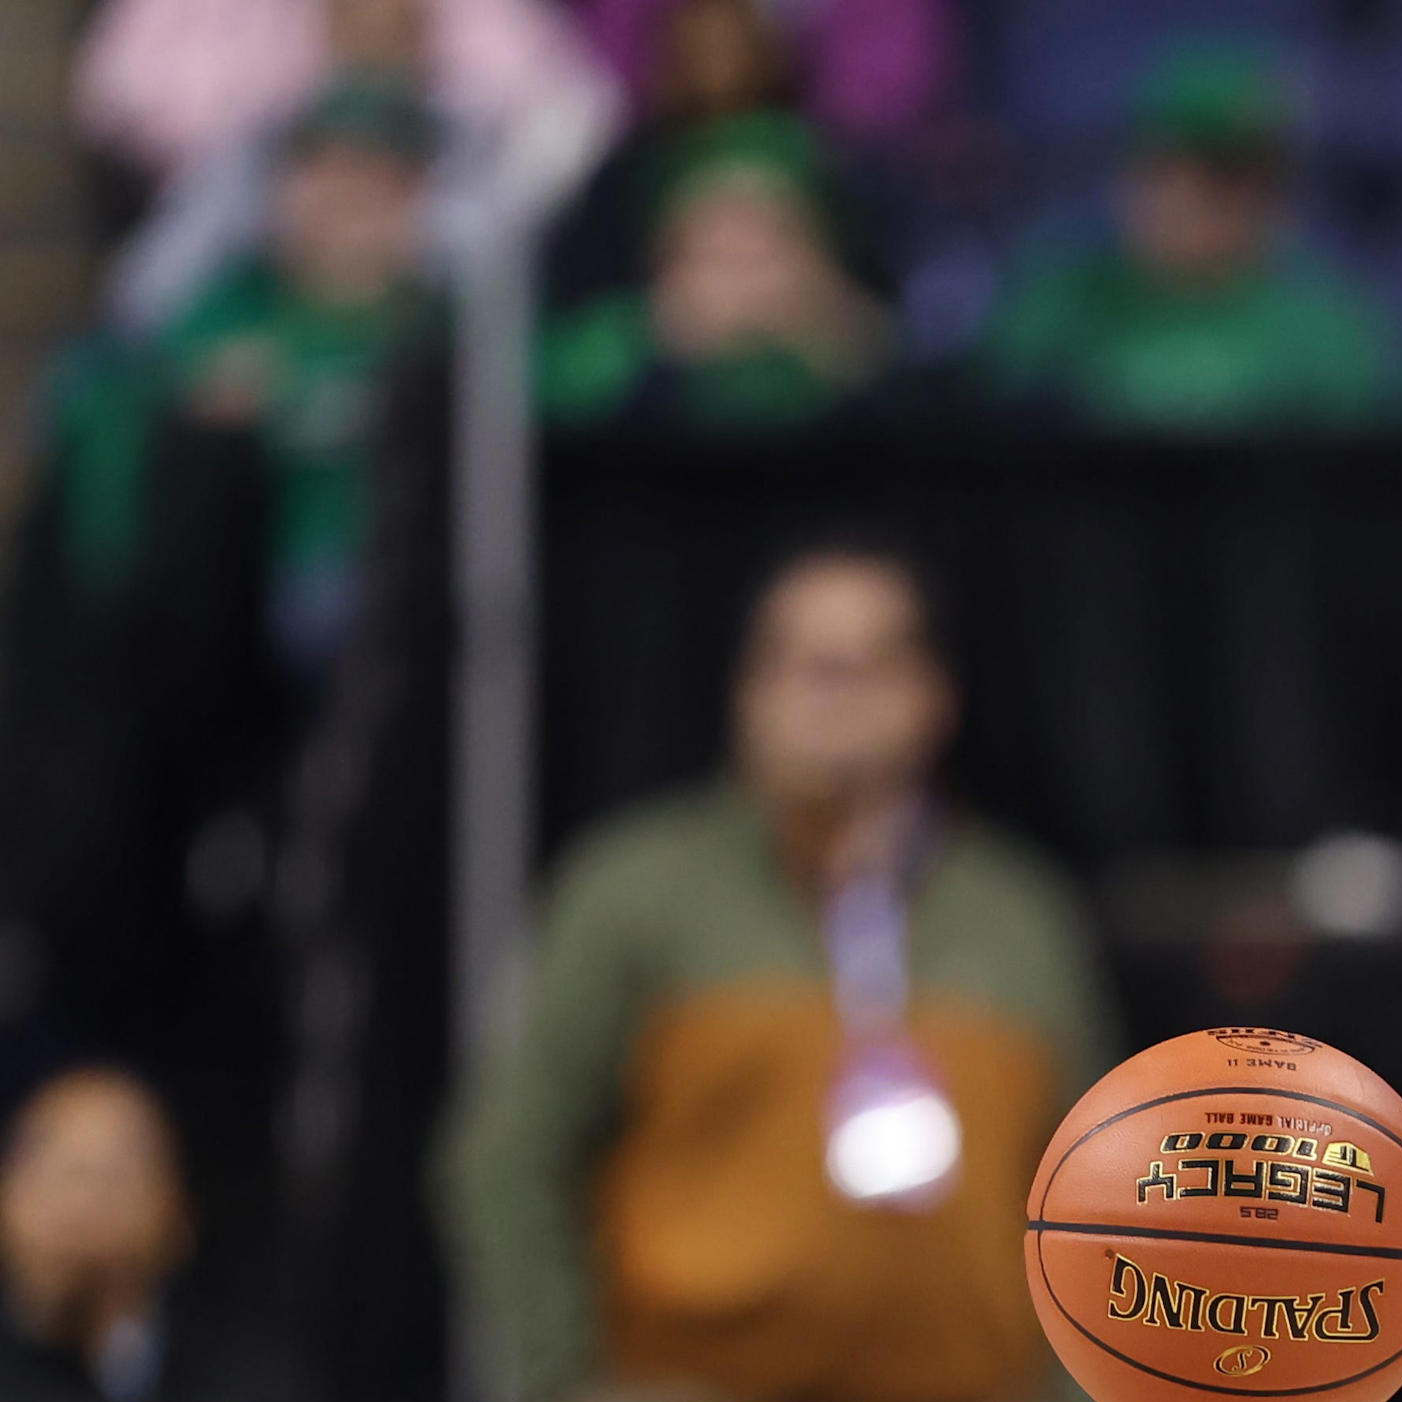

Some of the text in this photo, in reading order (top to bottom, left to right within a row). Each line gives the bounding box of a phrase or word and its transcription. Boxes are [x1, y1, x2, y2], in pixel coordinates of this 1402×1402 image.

[1204, 1112, 1236, 1125] BALL
[1240, 1114, 1274, 1126] GAME
[1137, 1161, 1386, 1224] LEGACY
[1108, 1253, 1386, 1344] SPALDING
